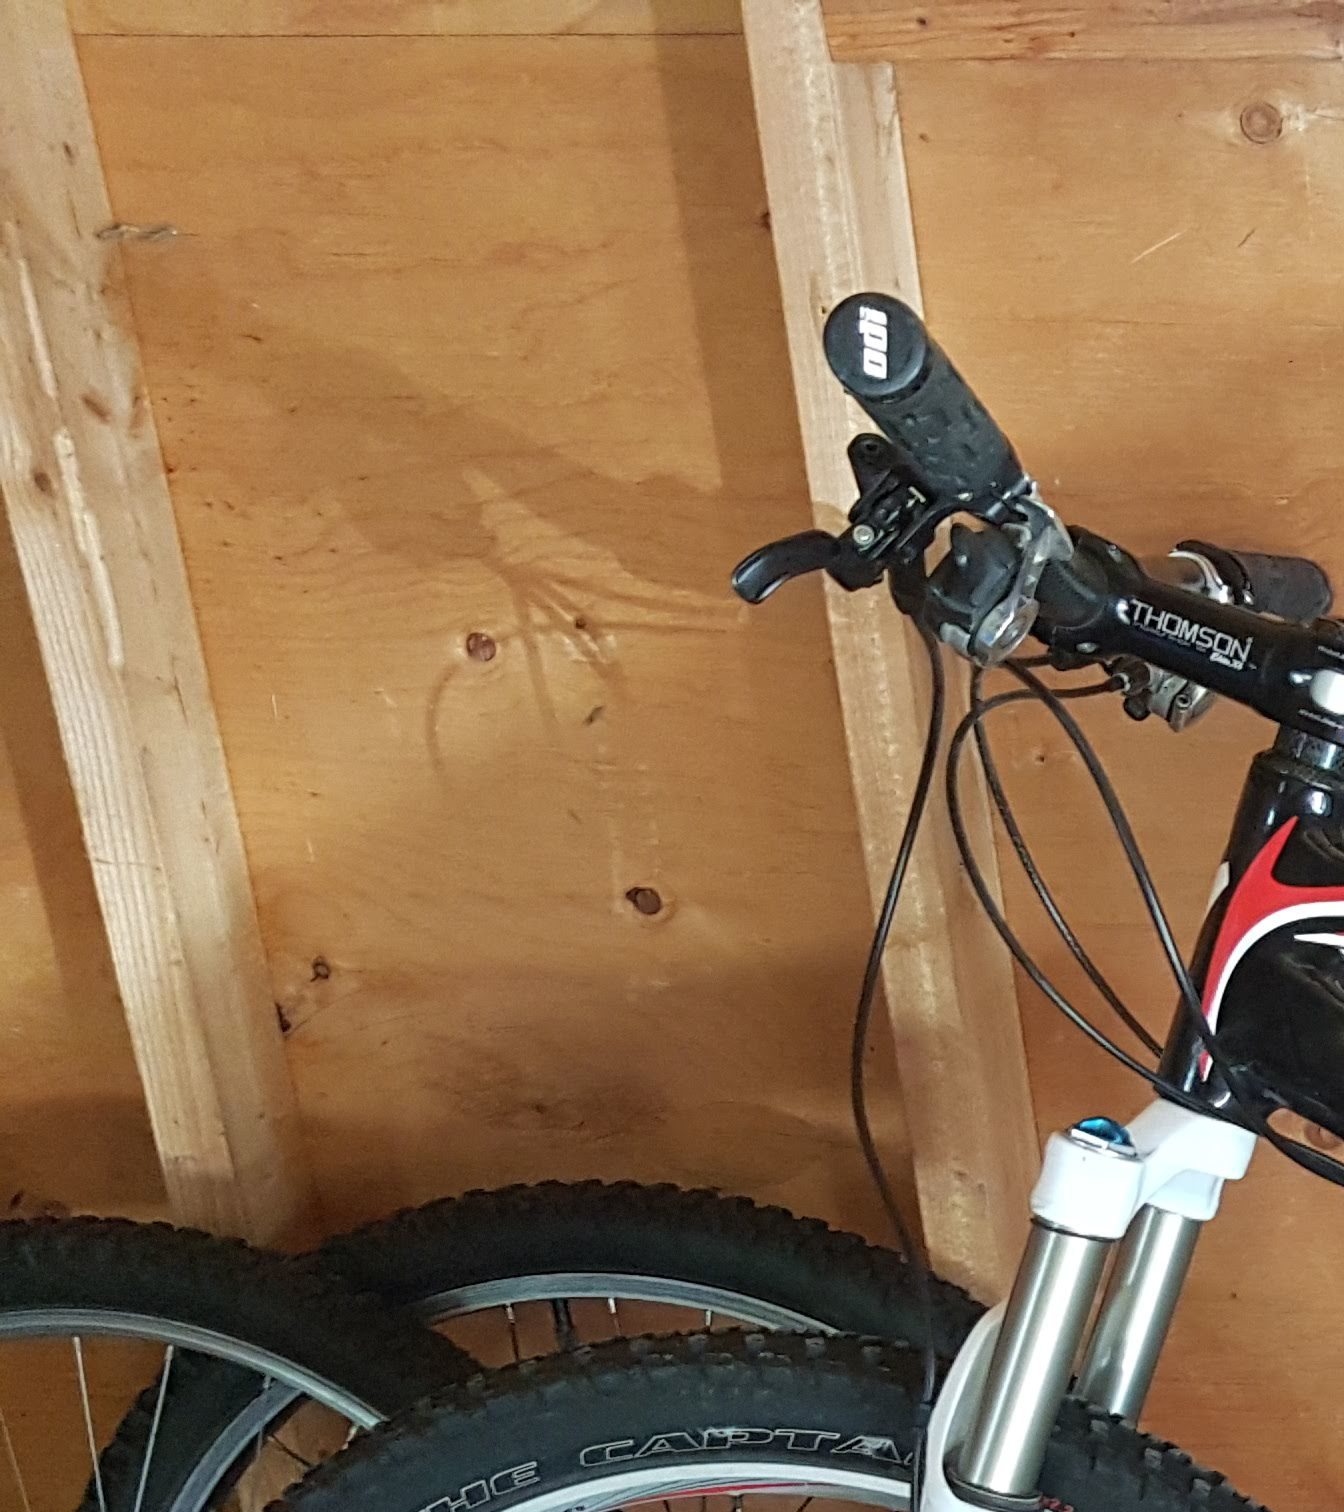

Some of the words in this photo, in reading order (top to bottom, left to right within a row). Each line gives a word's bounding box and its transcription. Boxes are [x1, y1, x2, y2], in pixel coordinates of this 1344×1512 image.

[859, 306, 888, 379] odi
[1130, 598, 1254, 663] THOMSON
[578, 1427, 914, 1469] CAPTA
